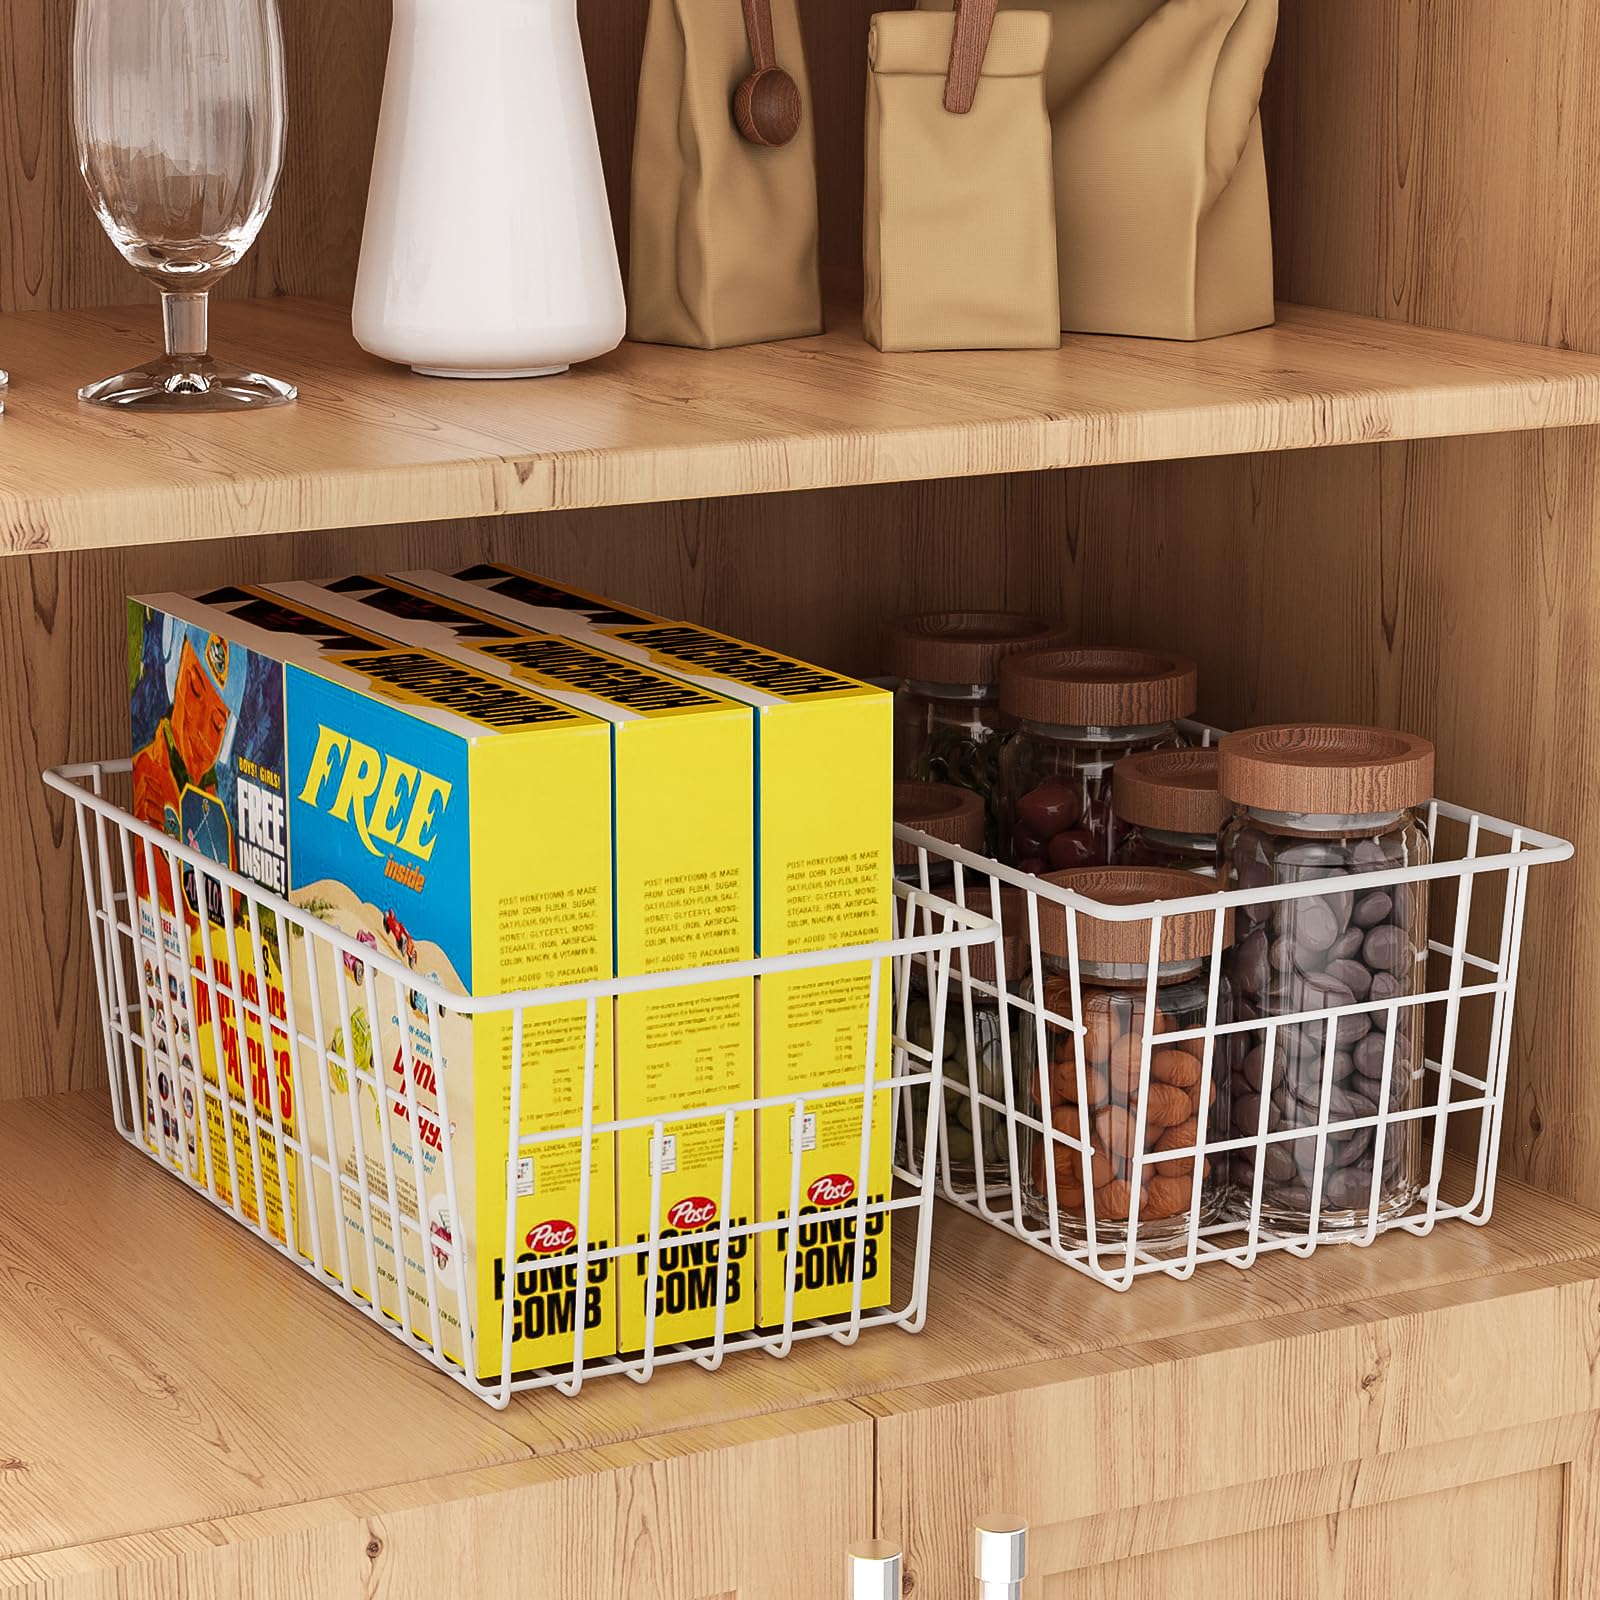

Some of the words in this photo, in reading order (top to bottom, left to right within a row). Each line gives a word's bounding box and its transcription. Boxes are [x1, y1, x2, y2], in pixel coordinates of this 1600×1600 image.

[239, 757, 258, 778] BOYS!
[259, 766, 281, 789] GIRLS!
[297, 724, 453, 862] FREE
[237, 777, 285, 858] FREE
[240, 840, 286, 894] INSIDE!
[384, 854, 426, 892] inside
[671, 1201, 714, 1225] Post
[811, 1178, 853, 1202] Post
[529, 1224, 574, 1249] Post
[644, 1262, 740, 1317] COMB
[784, 1238, 877, 1293] COMB
[502, 1286, 601, 1343] COMB
